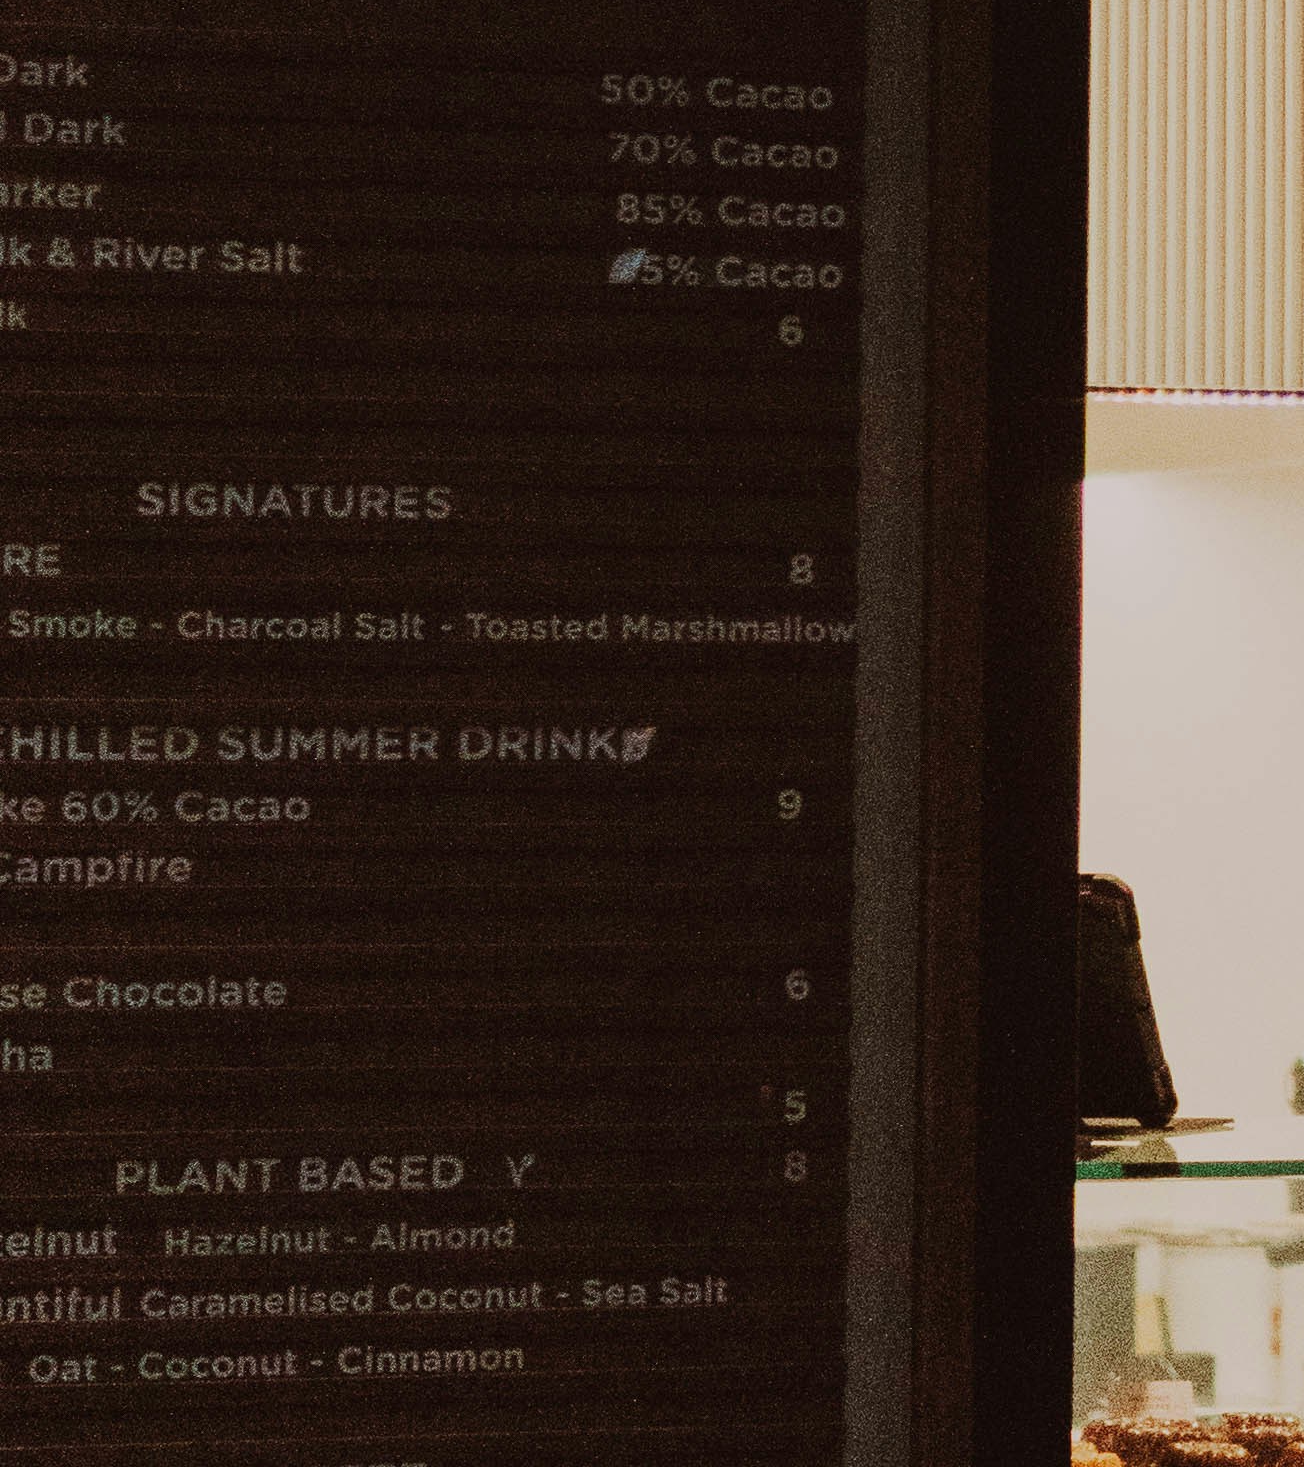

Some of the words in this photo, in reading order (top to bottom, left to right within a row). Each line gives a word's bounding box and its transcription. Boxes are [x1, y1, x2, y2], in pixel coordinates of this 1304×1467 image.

[600, 73, 690, 108] 50%
[705, 76, 834, 111] Cacao
[24, 113, 127, 145] Dark
[608, 132, 697, 166] 70%
[711, 134, 840, 170] Cacao
[616, 192, 703, 226] 85%
[717, 195, 846, 229] Cacao
[46, 236, 76, 267] &
[93, 237, 206, 271] River
[219, 239, 304, 274] Salt
[609, 248, 700, 287] 5%
[715, 256, 843, 290] Cacao
[779, 315, 804, 347] 6
[136, 482, 452, 520] SIGNATURES
[3, 543, 61, 577] RE
[788, 553, 815, 586] 8
[8, 607, 138, 640] Smoke
[177, 611, 342, 641] Charcoal
[354, 612, 425, 641] Salt
[466, 612, 608, 642] Toasted
[620, 613, 857, 644] Marshmallow
[0, 726, 200, 763] HILLED
[217, 726, 440, 764] SUMMER
[61, 791, 160, 825] 60%
[174, 790, 311, 824] Cacao
[776, 789, 802, 821] 9
[63, 974, 288, 1009] Chocolate
[784, 969, 811, 1002] 6
[2, 1039, 53, 1071] ha
[784, 1090, 807, 1123] 5
[115, 1158, 280, 1195] PLANT
[298, 1154, 465, 1193] BASED
[783, 1150, 808, 1182] 8
[0, 1225, 118, 1258] elnut
[164, 1225, 331, 1256] Hazelnut
[370, 1219, 516, 1251] Almond
[0, 1286, 122, 1323] ntiful
[139, 1285, 374, 1319] Caramelised
[387, 1280, 542, 1312] Coconut
[581, 1278, 648, 1307] Sea
[659, 1275, 729, 1304] Salt
[28, 1353, 98, 1384] Oat
[137, 1349, 298, 1380] Coconut
[336, 1345, 526, 1375] Cinnamon
